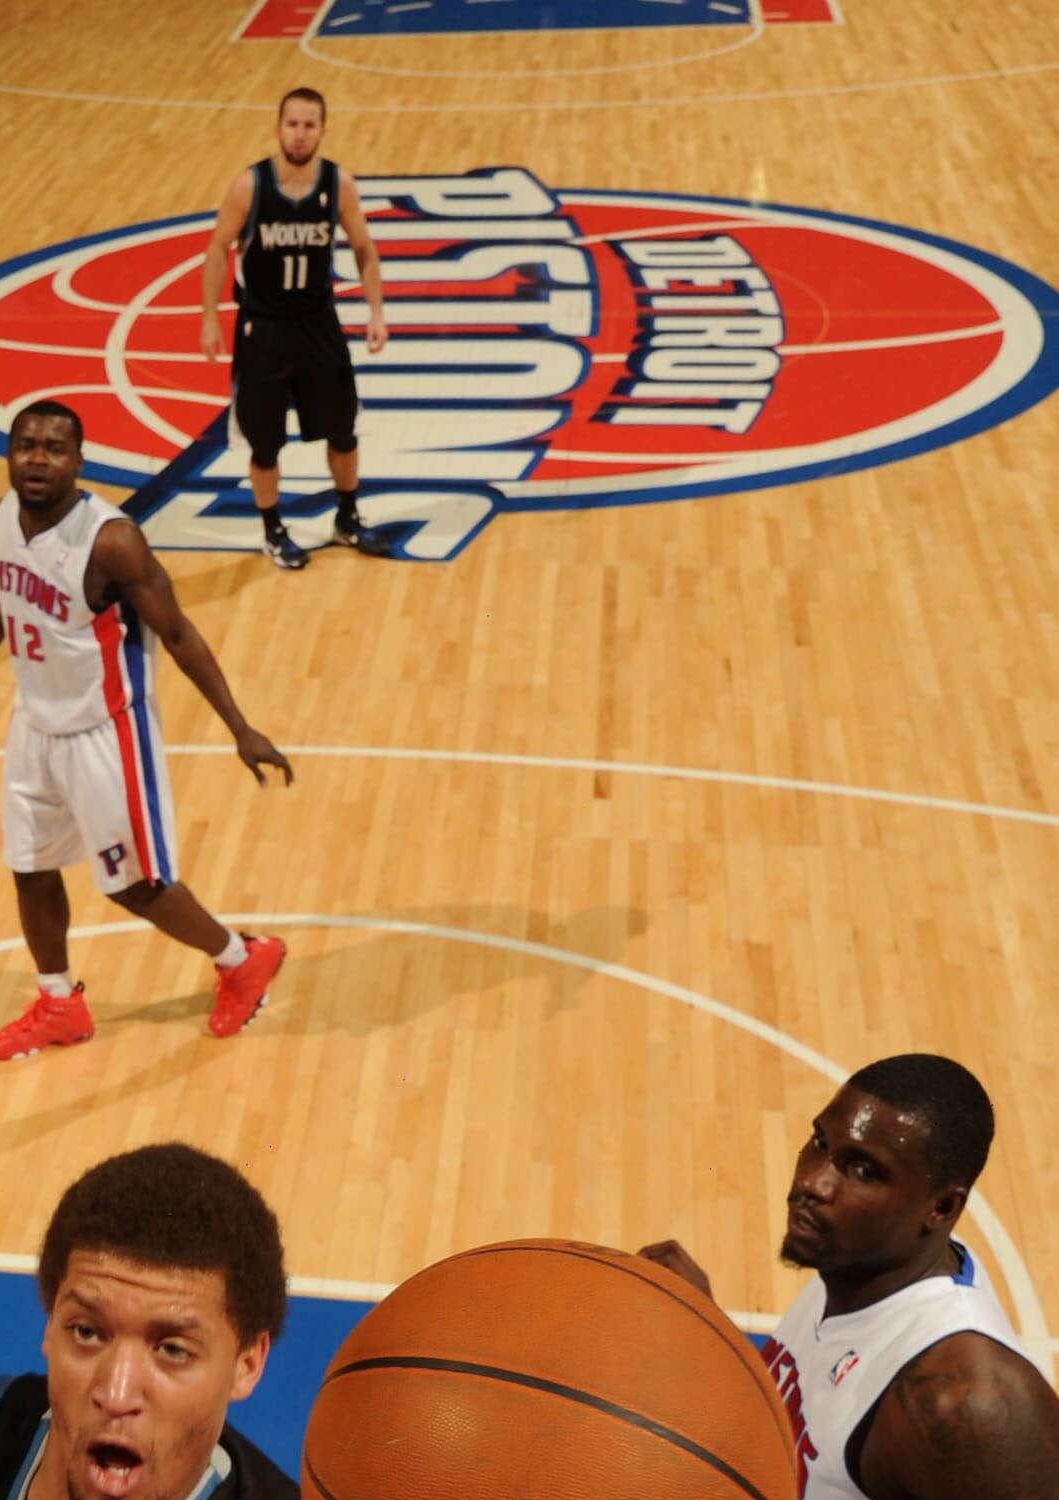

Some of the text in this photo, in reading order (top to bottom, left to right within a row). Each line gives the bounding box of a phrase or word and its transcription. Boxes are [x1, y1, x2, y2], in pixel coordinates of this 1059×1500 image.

[259, 222, 330, 250] WOLVES
[283, 255, 308, 290] 11
[600, 234, 785, 433] DETROIT
[7, 616, 46, 663] 12
[97, 841, 127, 878] P
